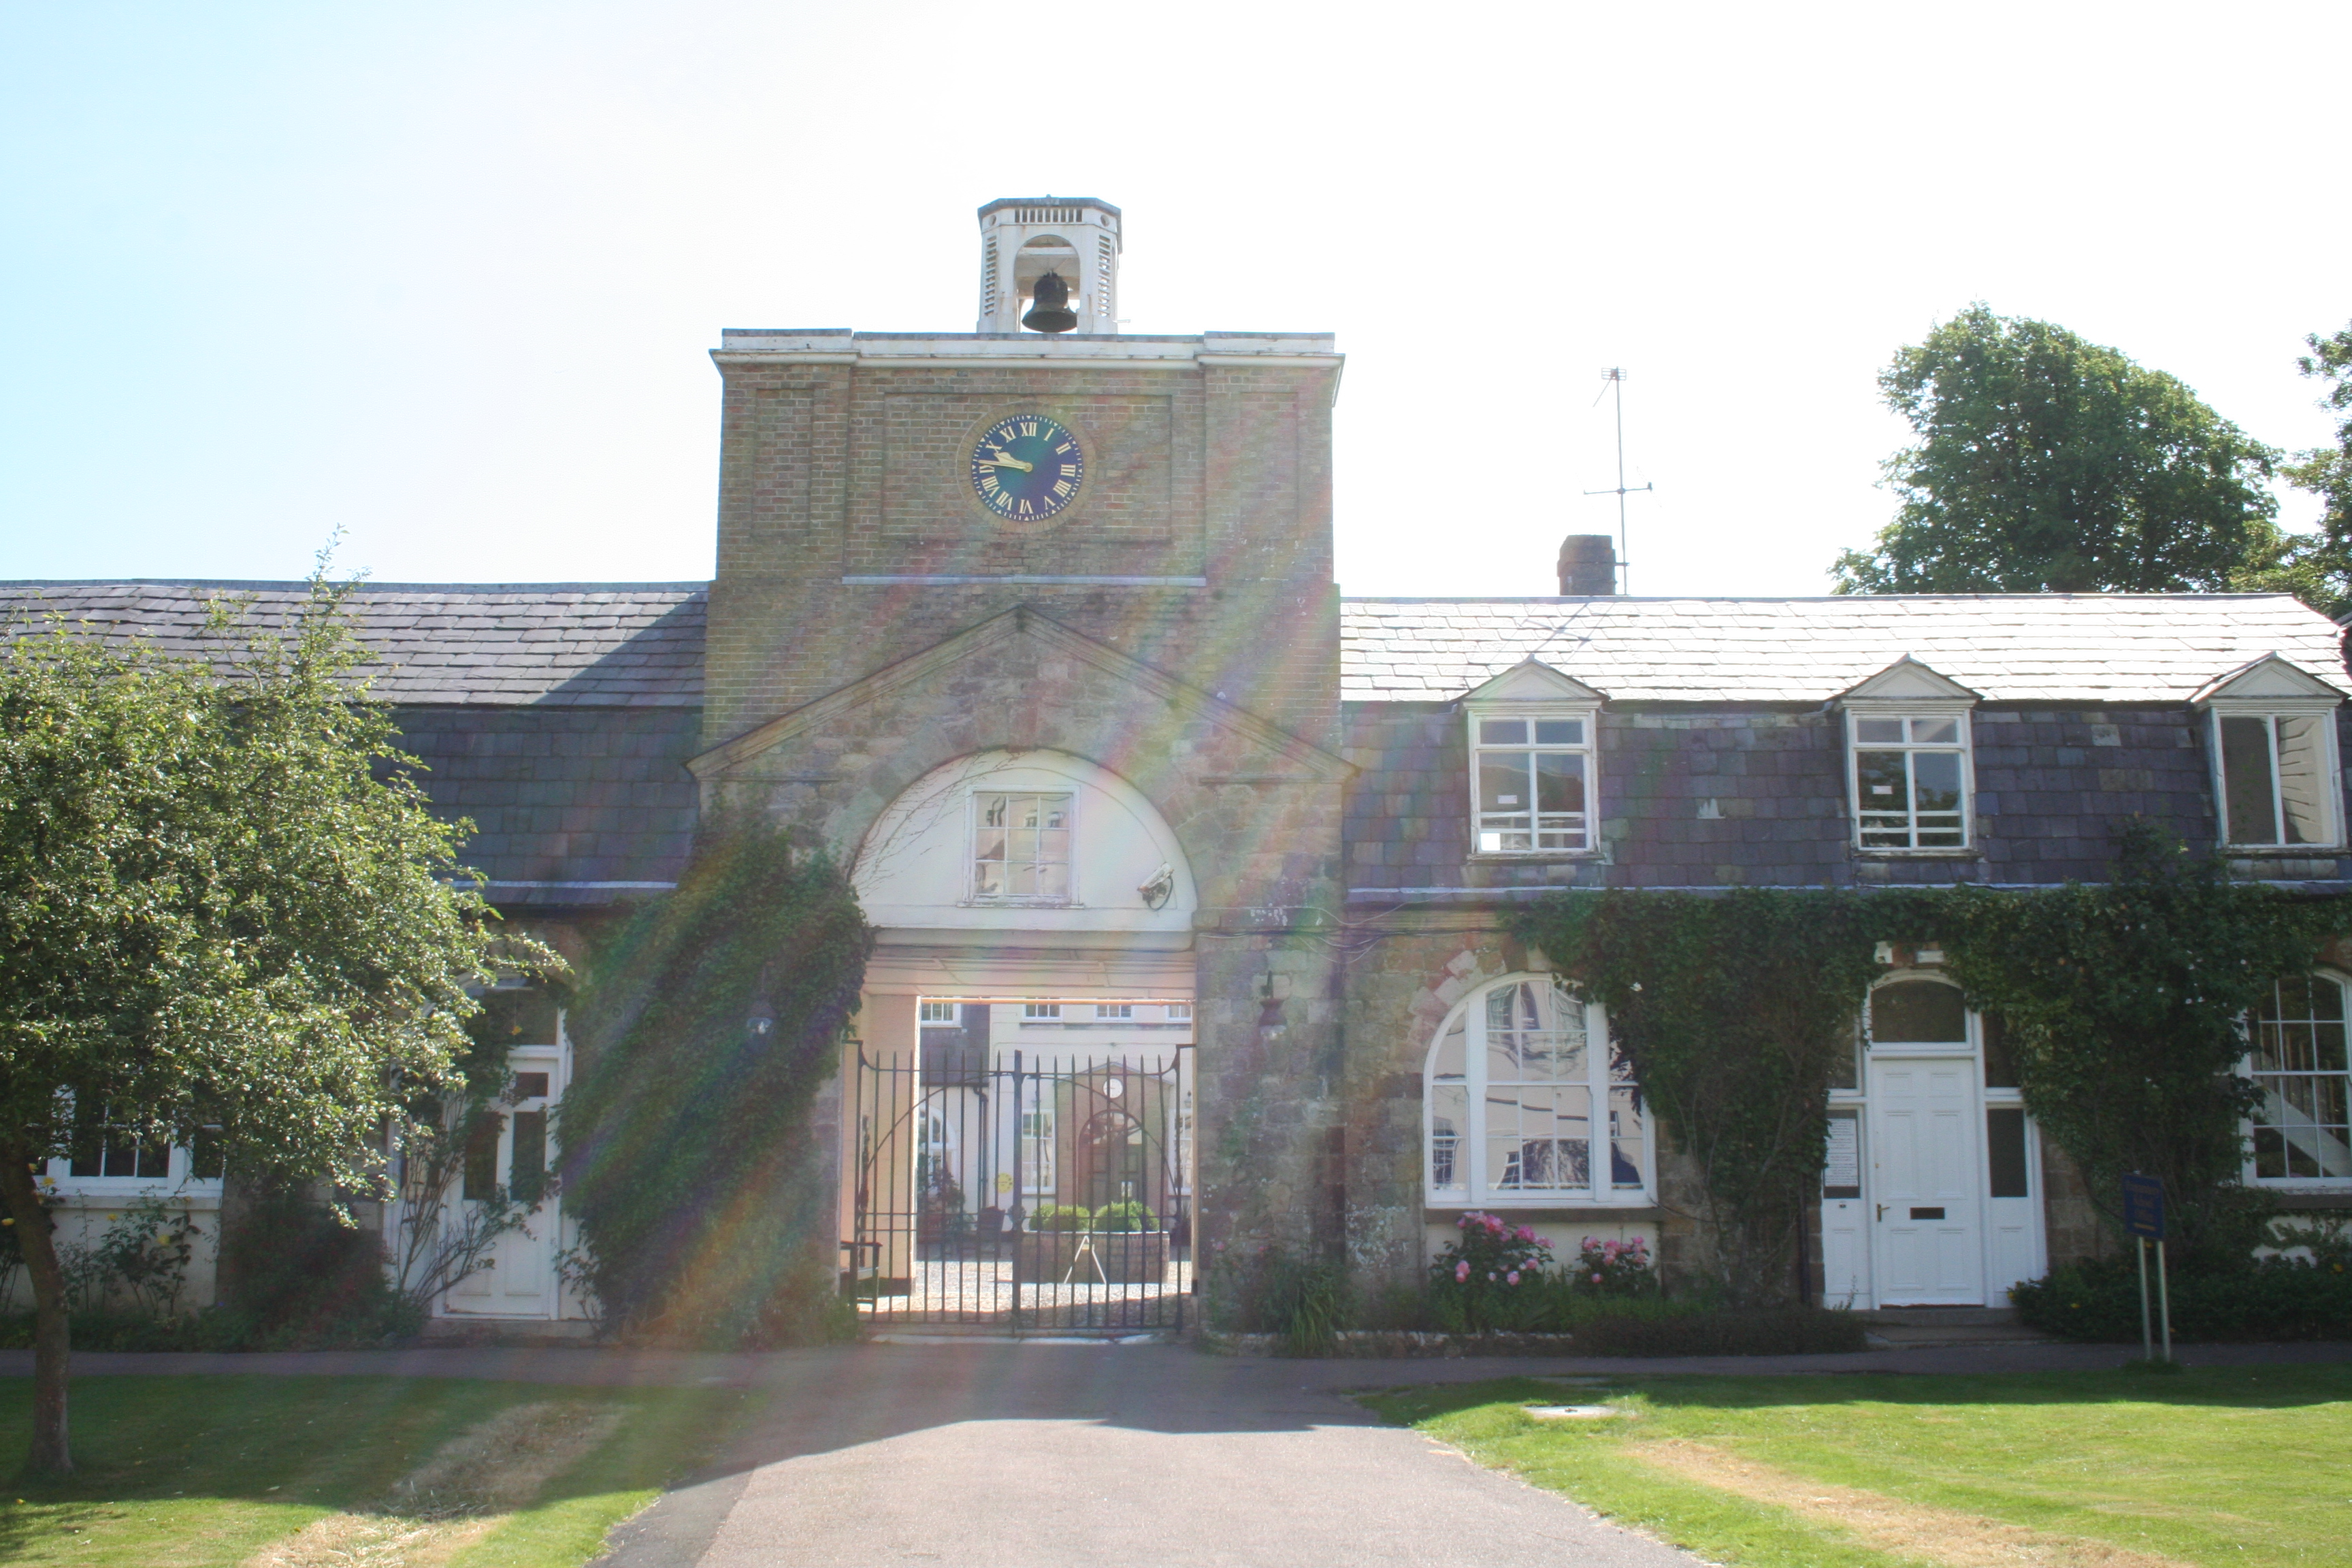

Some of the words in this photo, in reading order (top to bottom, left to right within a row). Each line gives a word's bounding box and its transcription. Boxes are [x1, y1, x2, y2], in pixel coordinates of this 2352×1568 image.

[1000, 426, 1016, 442] XI
[1019, 423, 1037, 436] XII
[1044, 428, 1054, 441] I
[985, 440, 1002, 453] X
[1056, 442, 1071, 455] II
[1060, 464, 1076, 477] III
[981, 476, 1000, 497] VIII
[1053, 480, 1072, 497] IIII
[996, 491, 1013, 510] VII
[1019, 499, 1033, 514] VI
[1045, 495, 1056, 510] V
